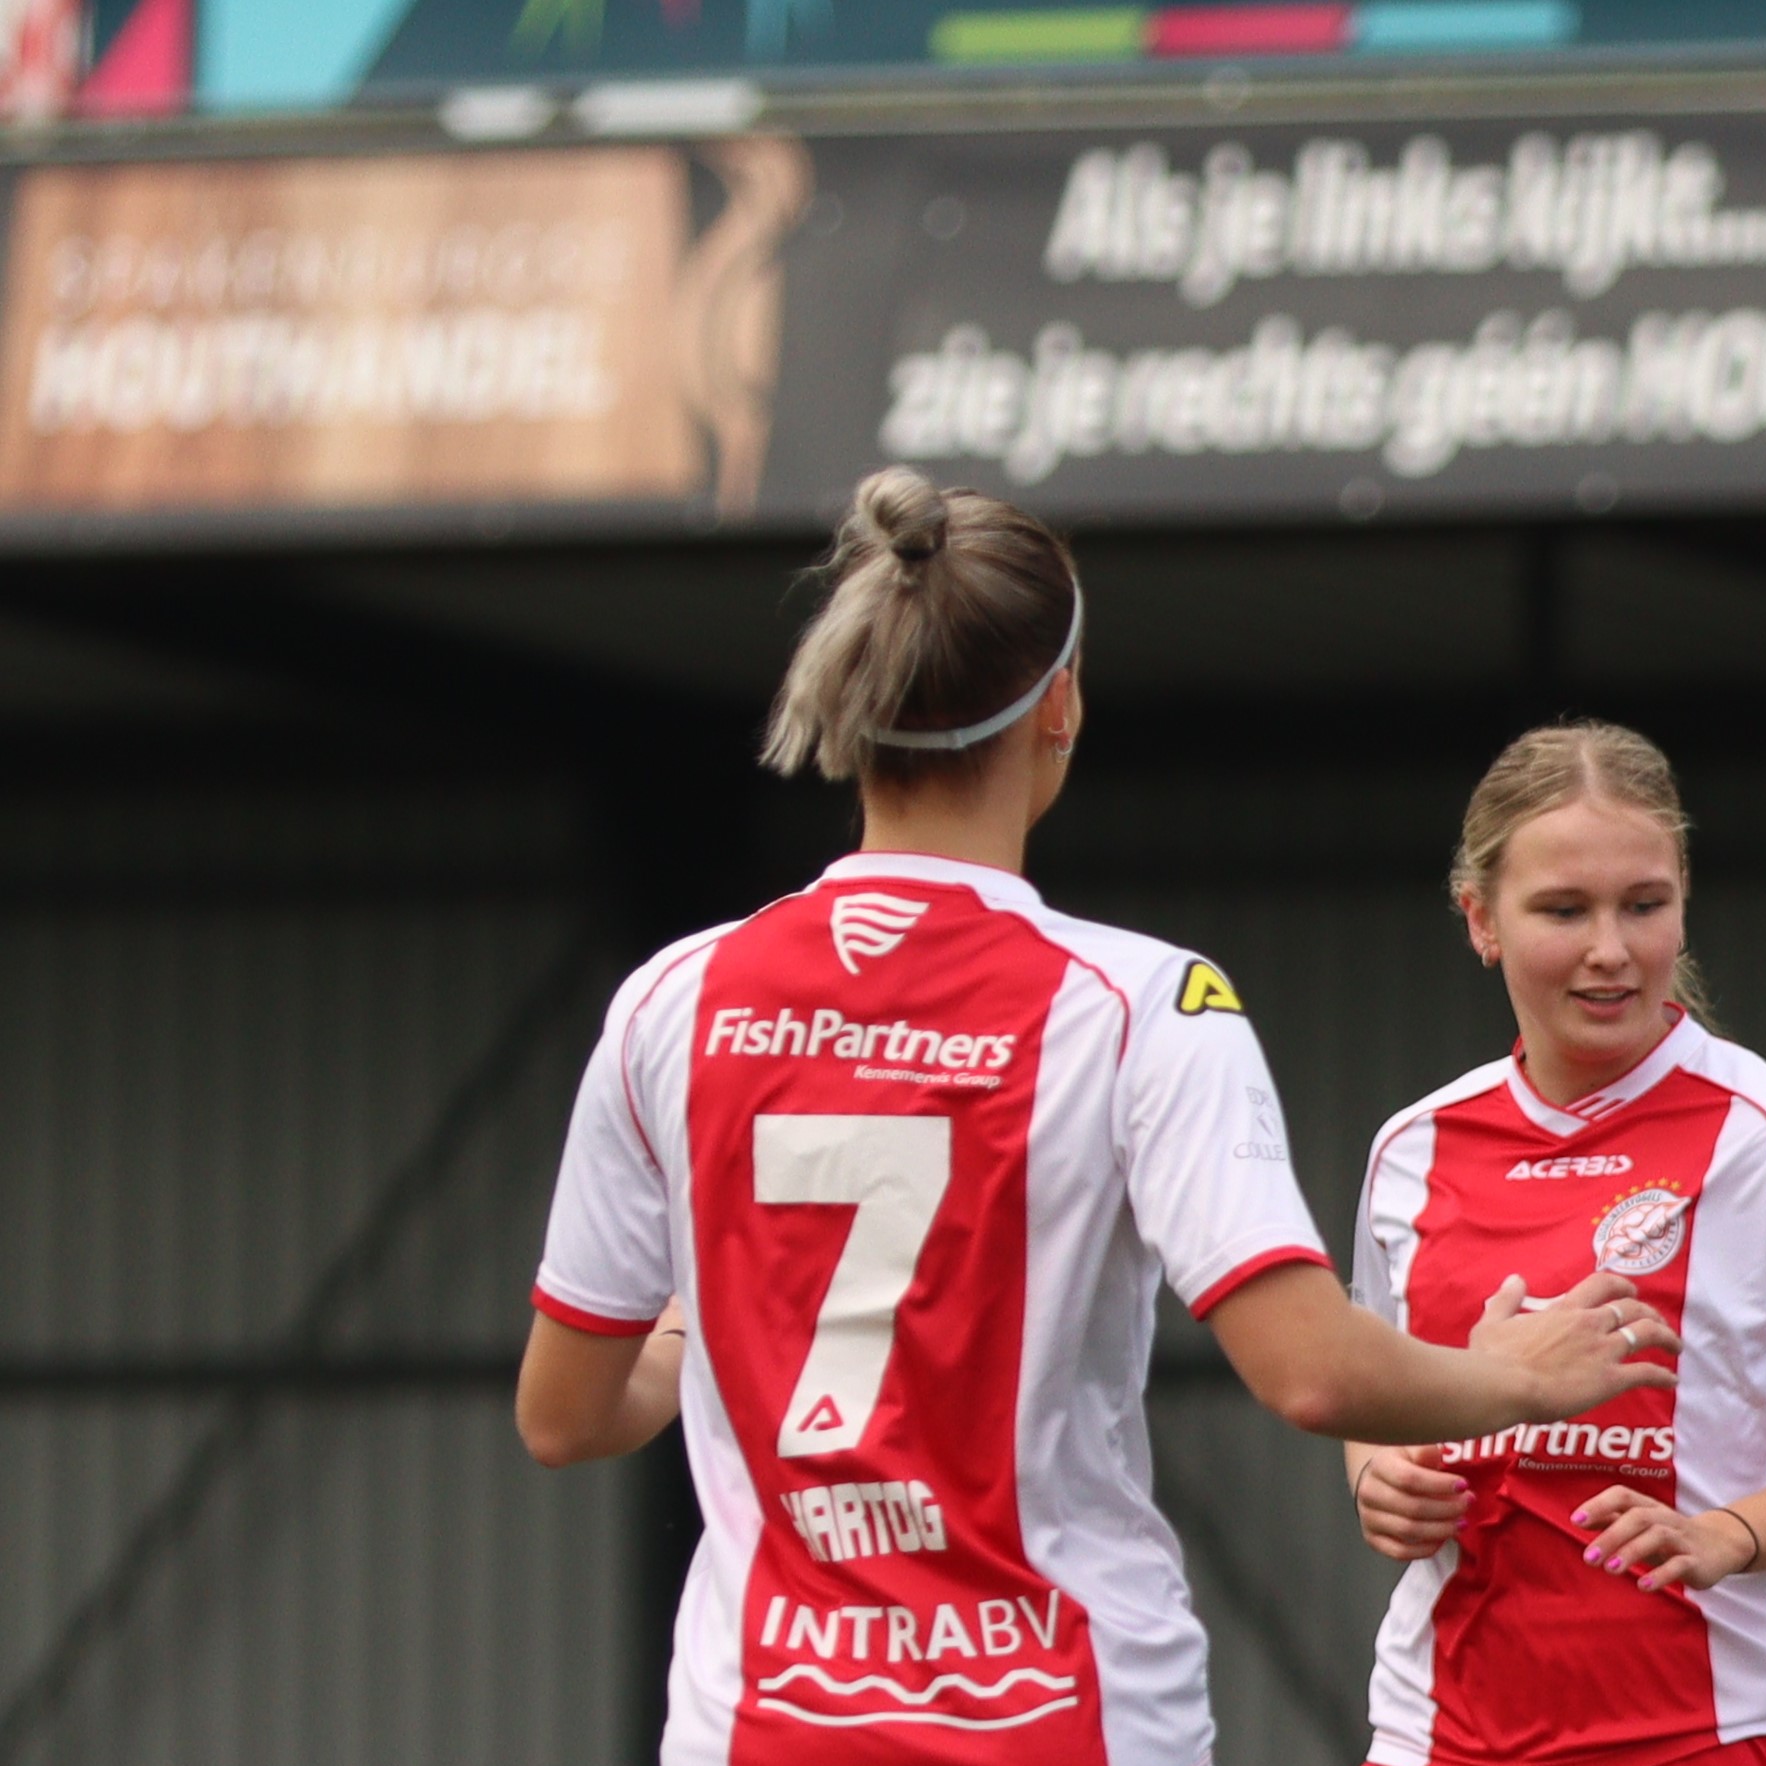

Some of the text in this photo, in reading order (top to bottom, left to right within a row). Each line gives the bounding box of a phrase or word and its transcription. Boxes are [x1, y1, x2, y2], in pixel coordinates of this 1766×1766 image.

[1046, 141, 1203, 281] Als
[1182, 142, 1292, 307] je
[1289, 136, 1507, 277] links
[30, 304, 620, 436] HOUTHANDEL
[878, 323, 1030, 459] zie
[1002, 321, 1119, 486] je
[1112, 314, 1402, 455] rechts
[703, 1005, 1017, 1069] FishPartners
[952, 1072, 1002, 1090] Group
[1504, 1154, 1634, 1181] ACERBIS
[752, 1113, 952, 1459] 7
[1618, 1463, 1669, 1479] Group
[779, 1479, 949, 1563] HARTOG
